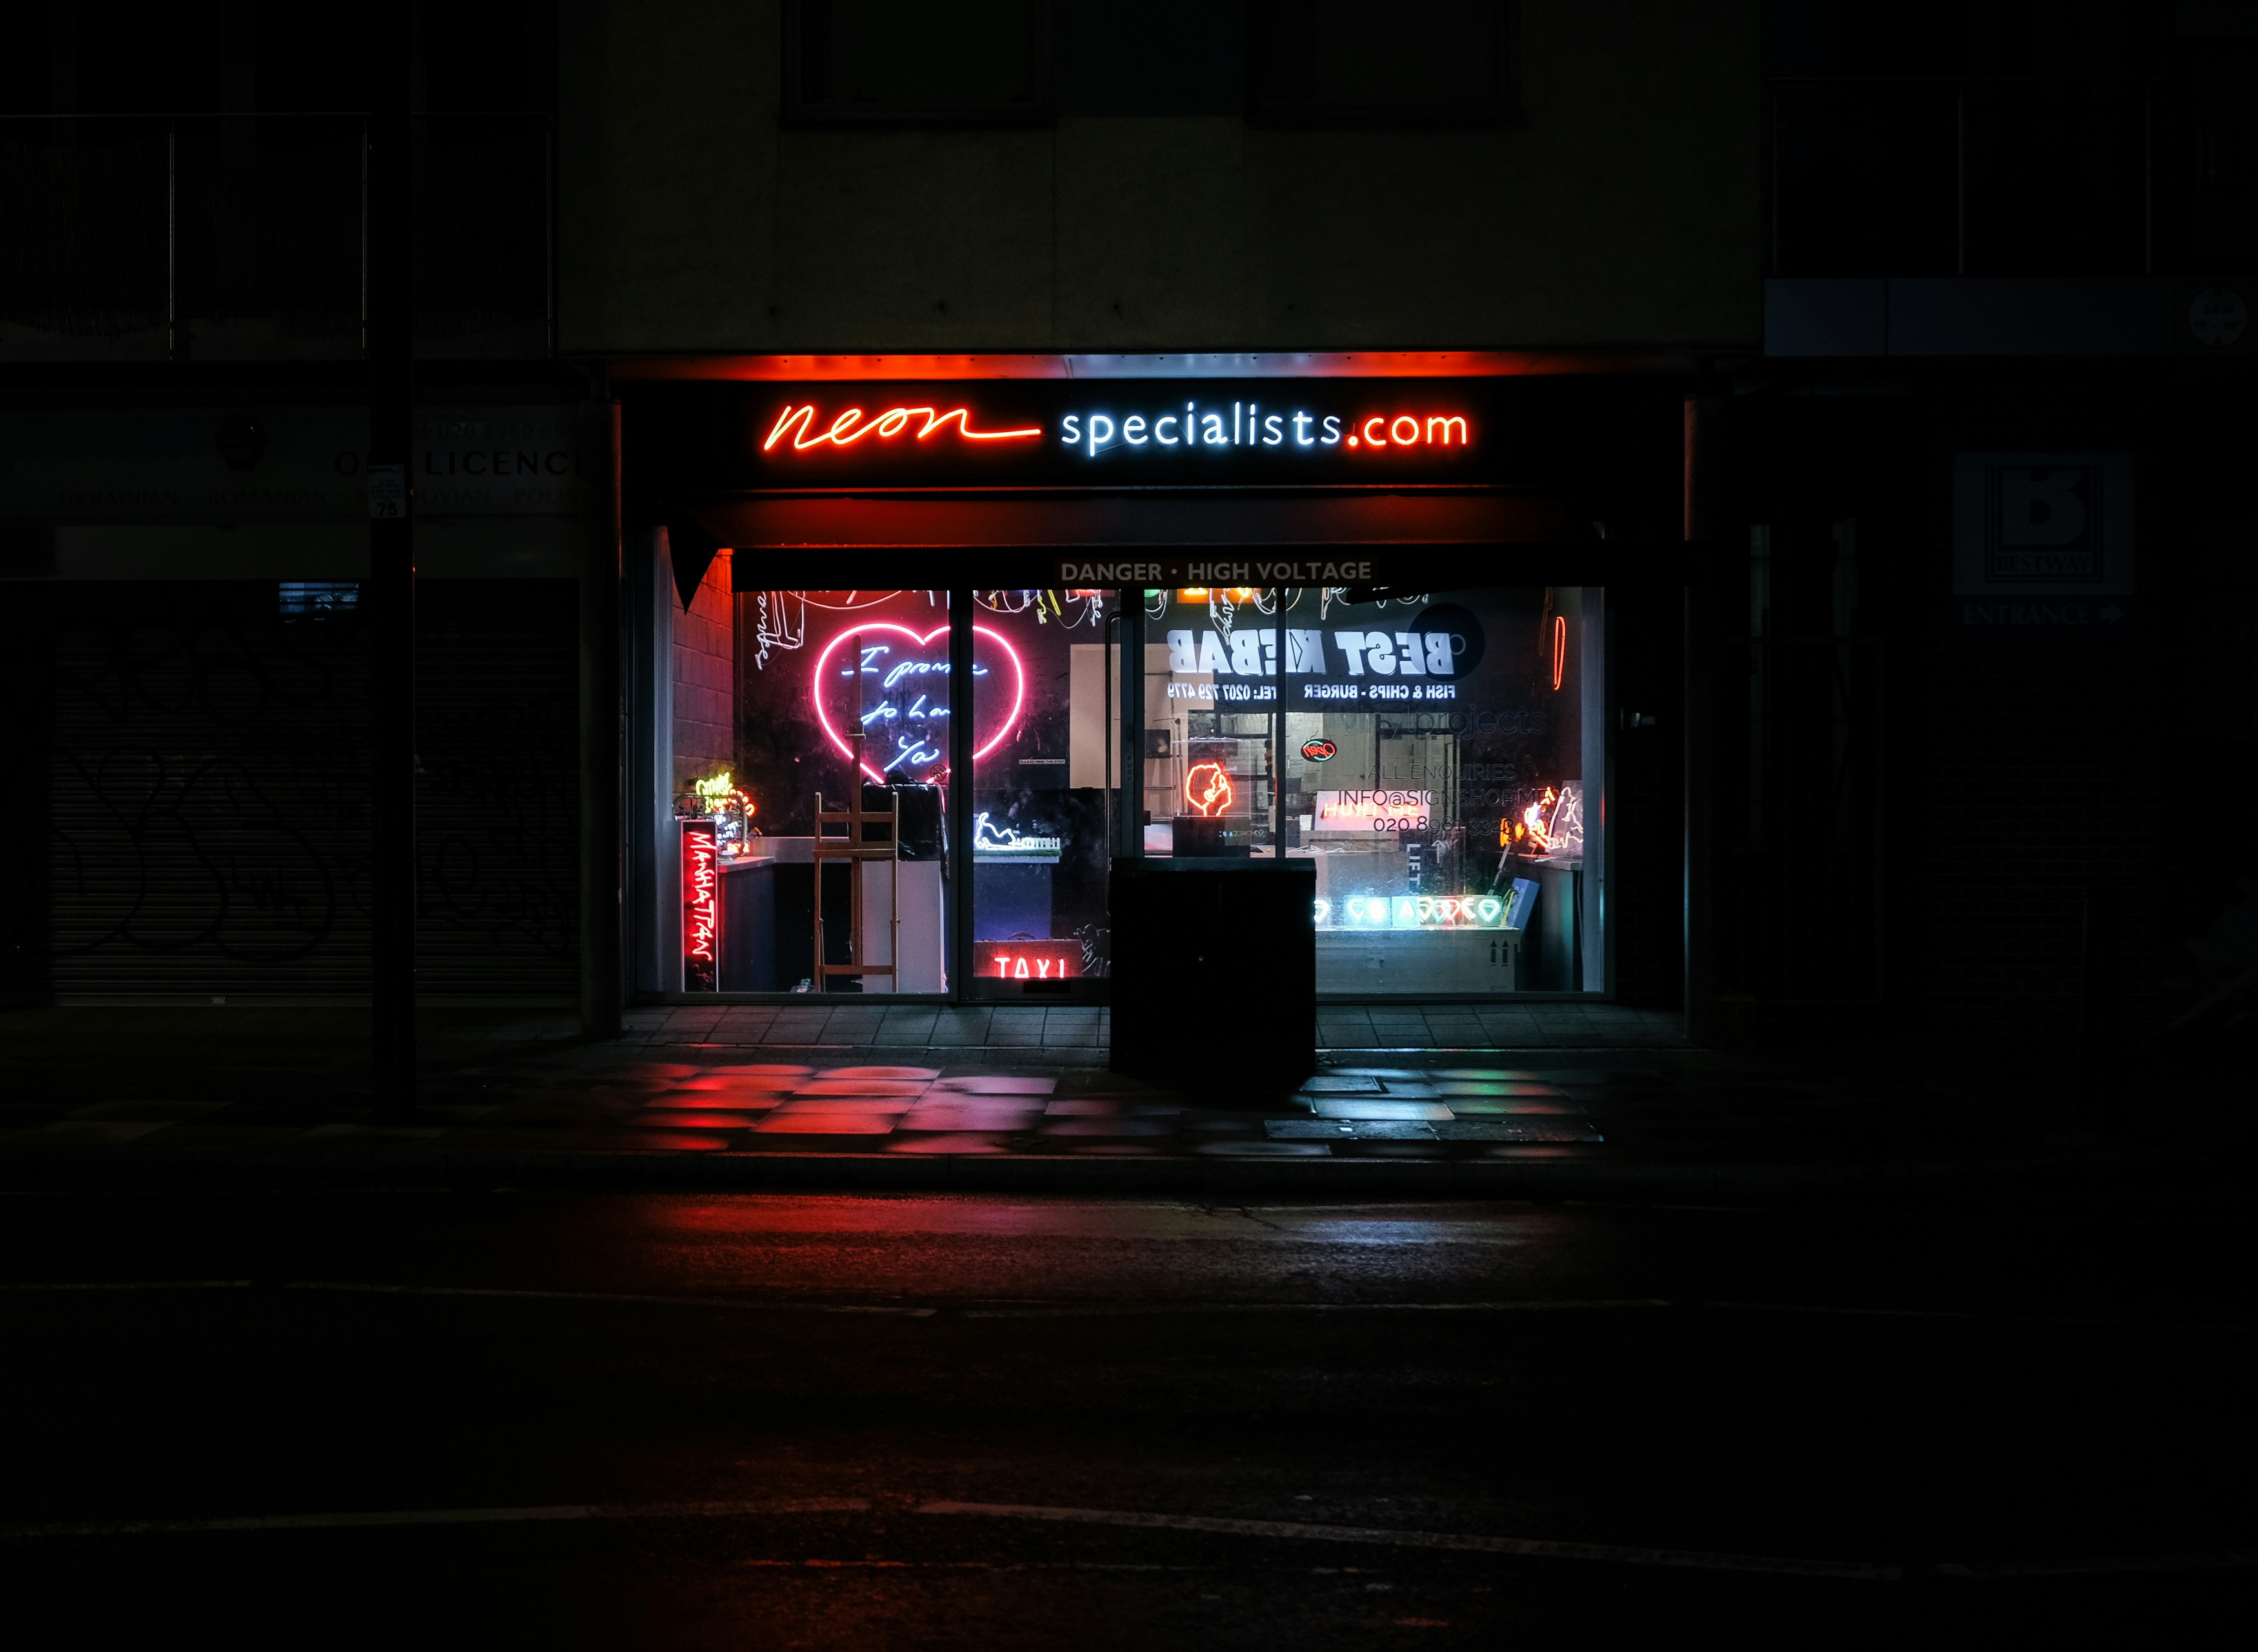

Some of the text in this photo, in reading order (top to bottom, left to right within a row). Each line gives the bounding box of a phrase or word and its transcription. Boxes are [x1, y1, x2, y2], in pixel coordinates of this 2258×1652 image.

[437, 423, 476, 440] 020
[764, 401, 1468, 457] neon specialists.com
[59, 488, 179, 506] UKRAINIAN
[207, 488, 326, 506] ROMANIAN
[514, 488, 579, 505] POLIS
[376, 502, 398, 516] 75
[1061, 561, 1372, 581] DANGER HIGH VOLTAGE
[1997, 555, 2090, 572] BESTWAY
[1963, 604, 2090, 624] ENTRANCE
[1368, 764, 1517, 781] ALL ENQUIRIES
[1324, 802, 1379, 817] HURT
[1374, 818, 1410, 832] 020
[1416, 815, 1466, 836] 8981
[685, 831, 718, 962] MANHATTAN
[994, 957, 1064, 979] TAXI
